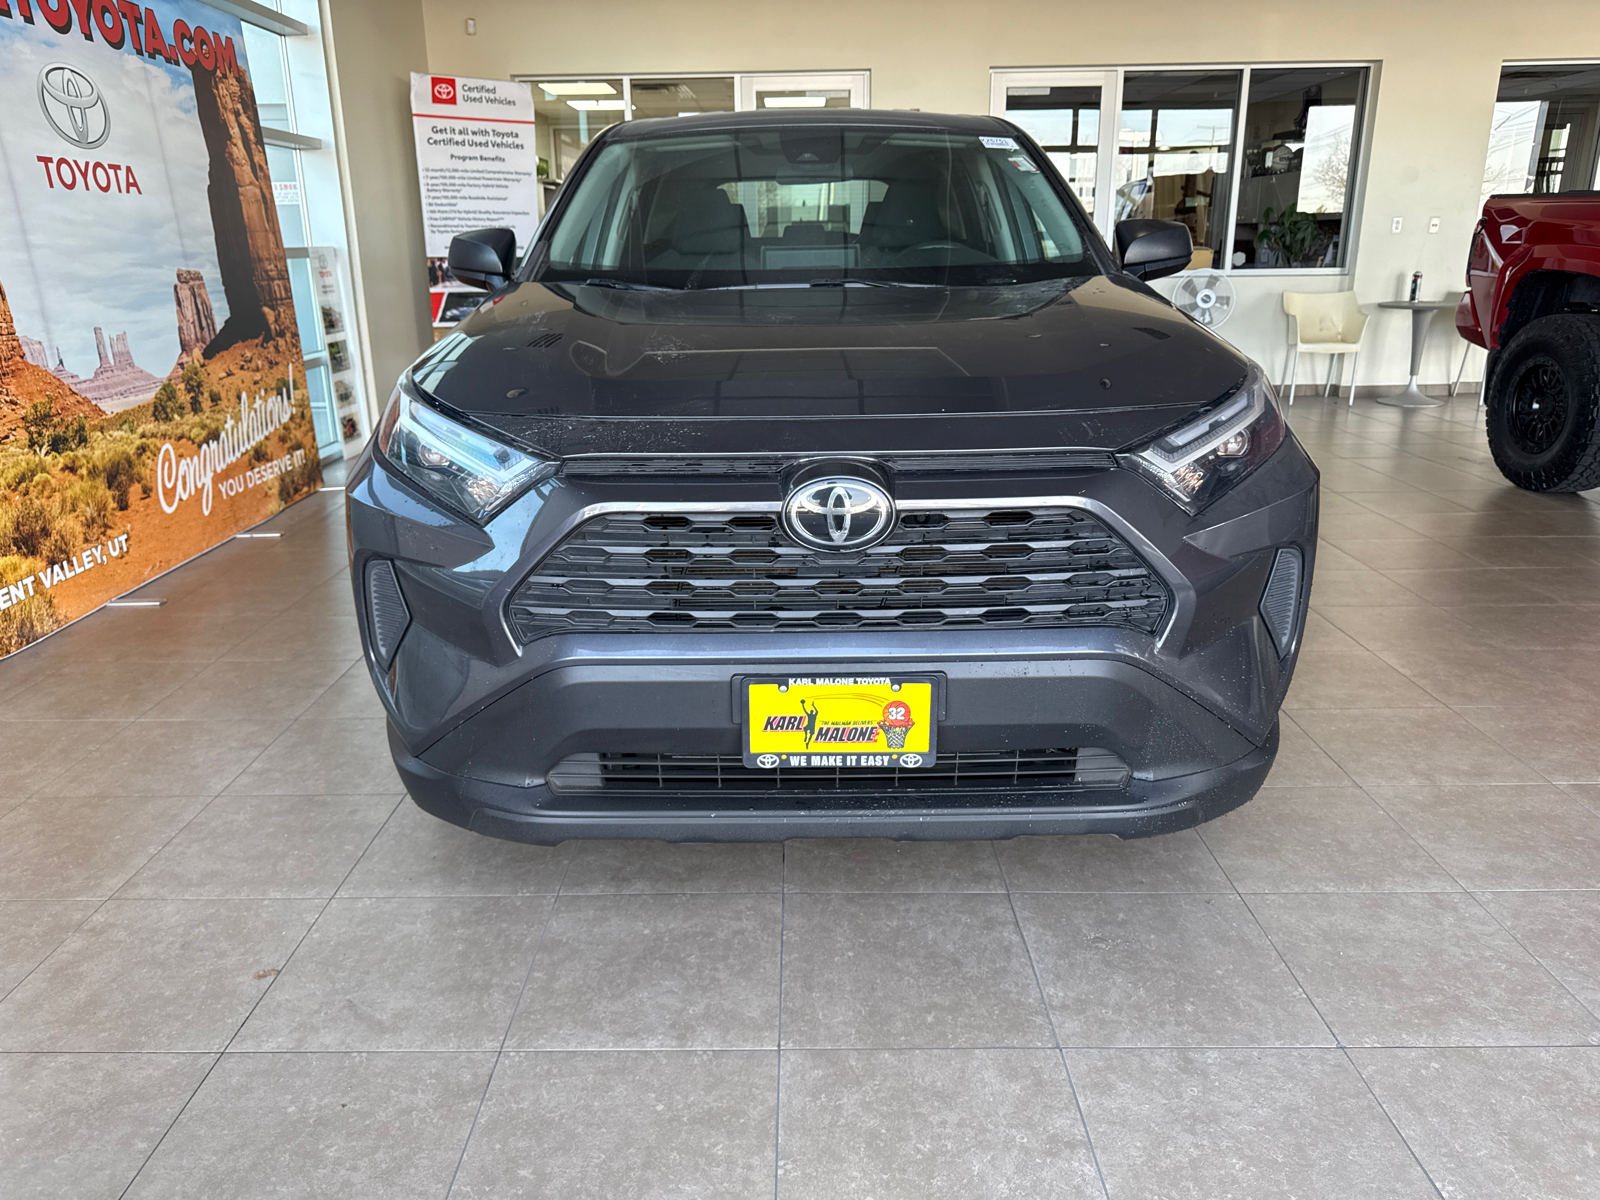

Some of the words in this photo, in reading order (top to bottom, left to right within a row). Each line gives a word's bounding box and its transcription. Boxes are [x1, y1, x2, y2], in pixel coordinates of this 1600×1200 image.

[462, 84, 496, 94] Certified
[462, 95, 483, 103] Used
[484, 97, 516, 106] Vehicles
[432, 126, 448, 135] Get
[450, 127, 457, 135] it
[458, 127, 469, 136] all
[471, 128, 490, 137] with
[491, 130, 519, 139] Toyota
[427, 137, 466, 147] Certified
[467, 139, 489, 148] Used
[490, 140, 524, 150] Vehicles
[450, 154, 478, 162] Program
[36, 156, 142, 194] TOYOTA
[157, 363, 297, 516] Congratulations!
[218, 474, 244, 500] YOU
[246, 454, 292, 488] DESERVE
[293, 448, 306, 467] IT!
[38, 544, 107, 589] VALLEY,
[107, 534, 129, 558] UT
[888, 707, 905, 720] 32
[762, 715, 806, 732] KARL
[814, 726, 879, 743] MALONE
[790, 756, 807, 766] WE
[811, 756, 842, 766] MAKE
[847, 756, 858, 766] IT
[860, 755, 889, 766] EASY
